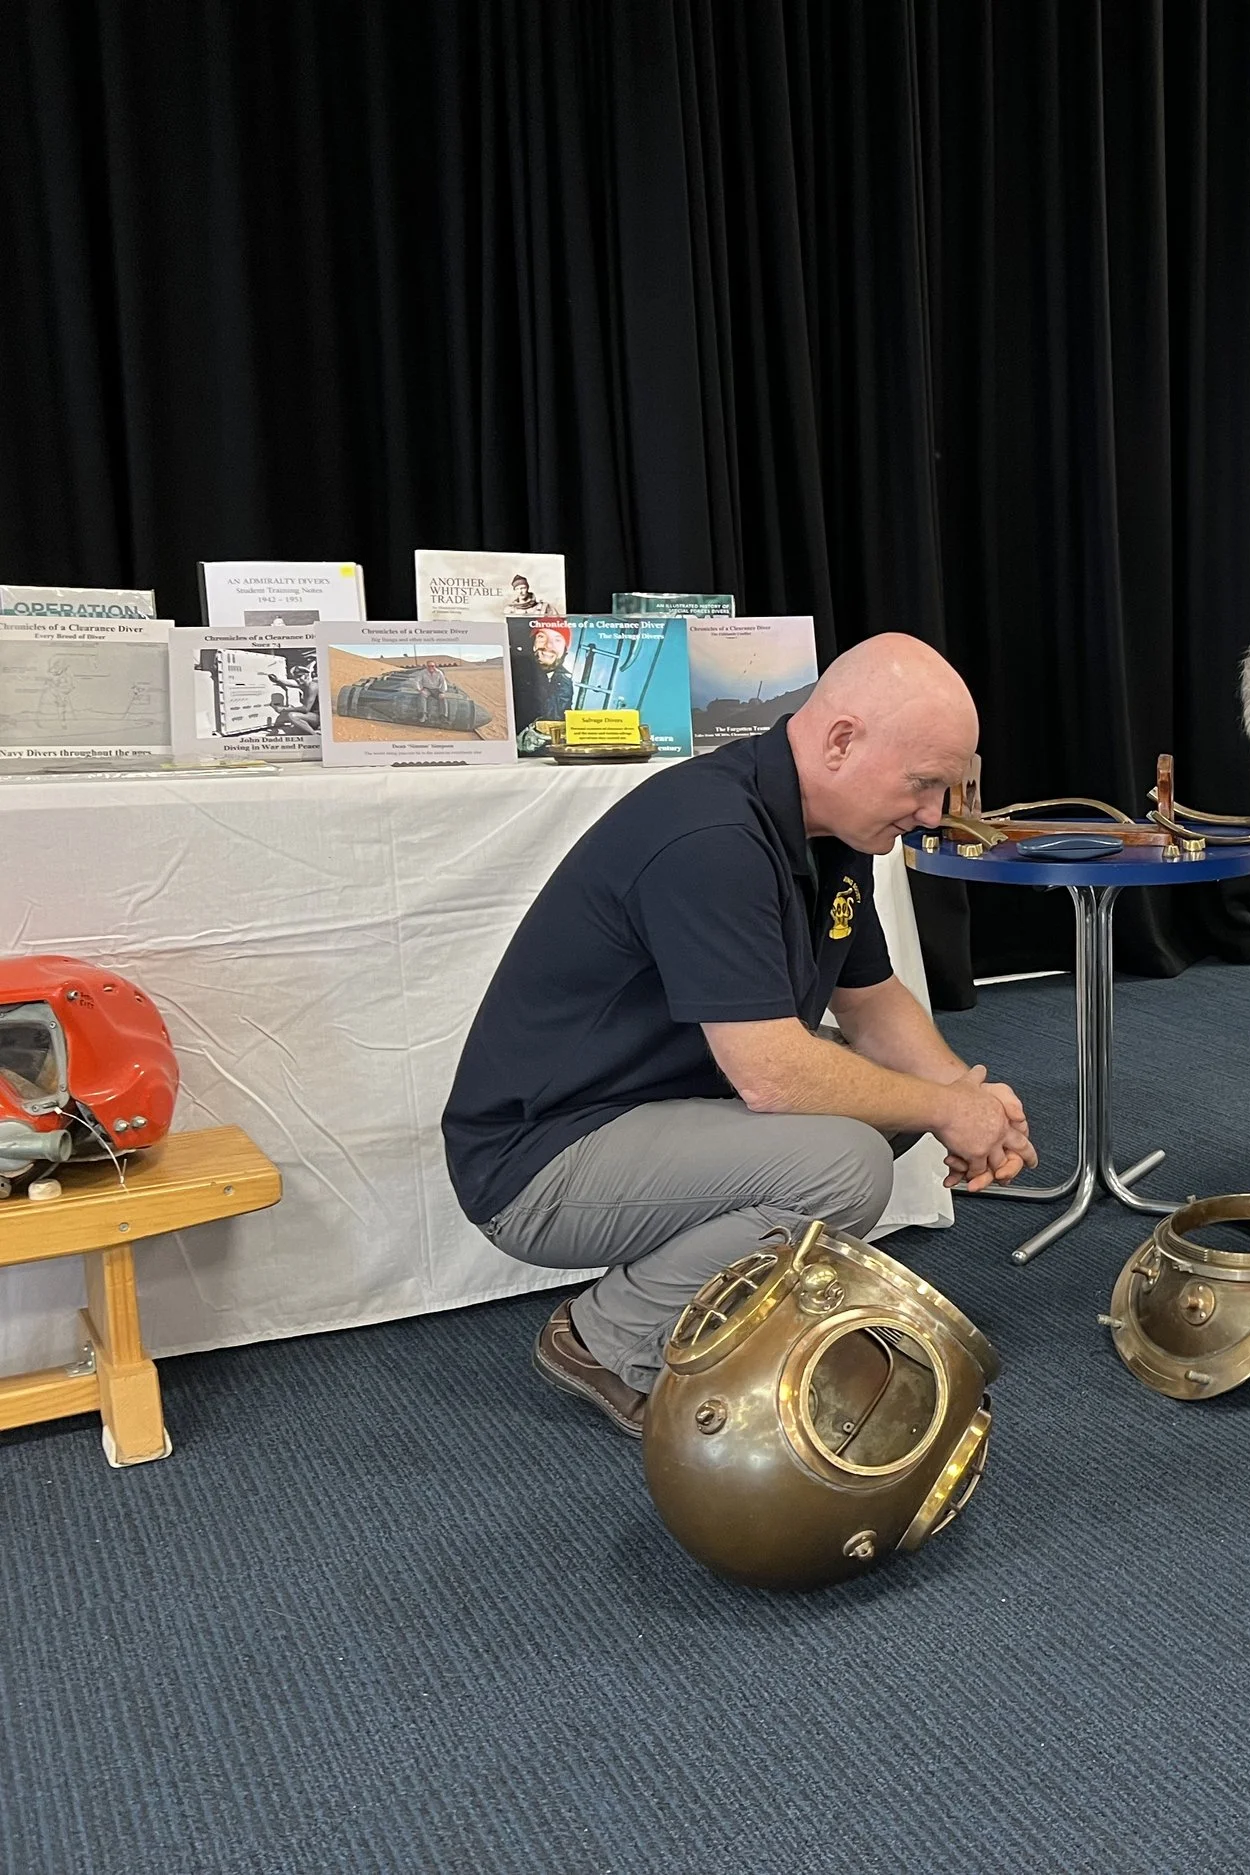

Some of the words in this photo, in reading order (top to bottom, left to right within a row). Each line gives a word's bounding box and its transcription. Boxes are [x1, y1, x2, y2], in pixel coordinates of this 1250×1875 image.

[430, 577, 485, 587] ANOTHER
[430, 587, 503, 597] WHITSTABLE
[431, 595, 469, 604] TRADE
[14, 602, 139, 617] OPERATION
[48, 623, 58, 631] of
[68, 624, 116, 632] Clearance
[118, 625, 144, 633] Diver
[528, 620, 577, 629] Chronicles
[578, 620, 589, 629] of
[596, 620, 640, 629] Clearance
[642, 620, 665, 629] Diver
[598, 632, 613, 640] The
[640, 632, 664, 640] Divers
[26, 749, 58, 757] Divers
[59, 749, 112, 759] throughout
[114, 749, 130, 757] the
